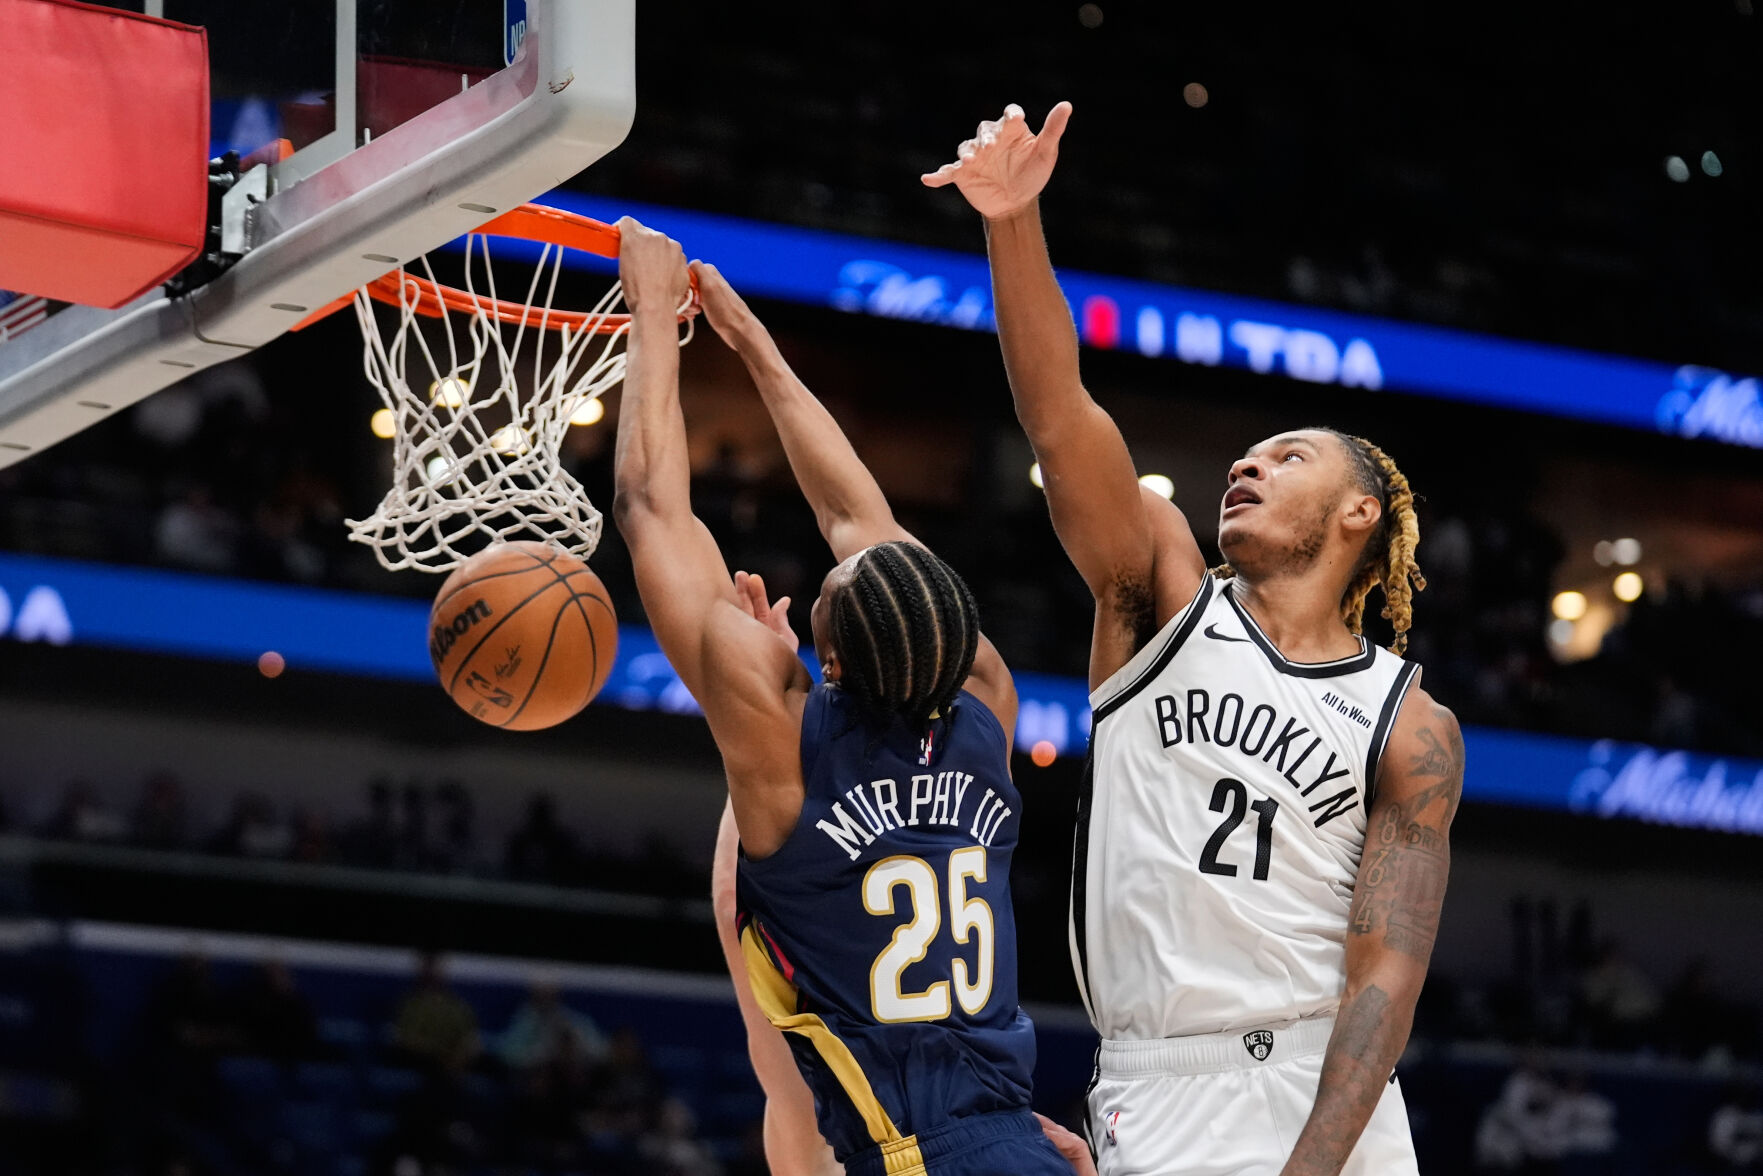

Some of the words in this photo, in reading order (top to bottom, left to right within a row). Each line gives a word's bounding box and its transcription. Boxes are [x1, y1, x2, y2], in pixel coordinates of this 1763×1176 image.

[1321, 692, 1339, 707] All
[1336, 700, 1348, 715] In
[1348, 706, 1372, 728] Won
[1155, 689, 1359, 829] BROOKLYN
[815, 771, 974, 861] MURPHY
[1198, 778, 1280, 881] 21
[861, 846, 995, 1023] 25
[1245, 1031, 1273, 1048] NETS
